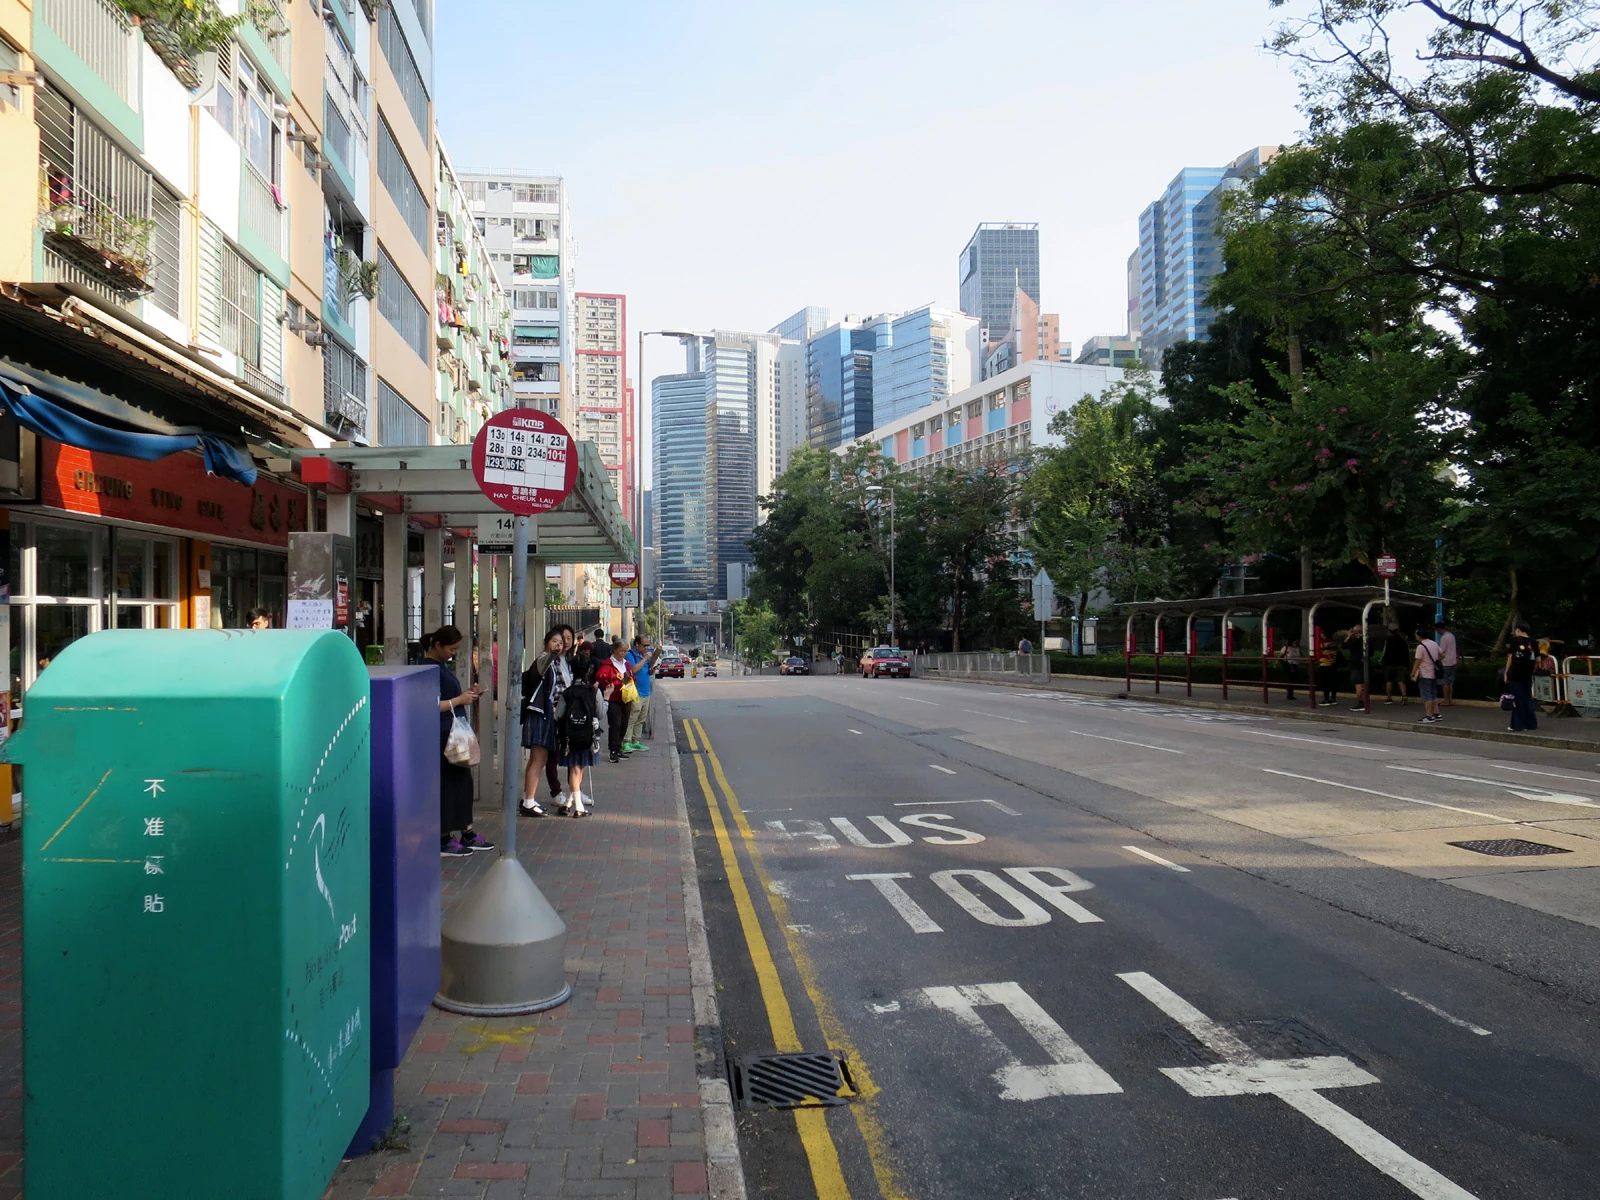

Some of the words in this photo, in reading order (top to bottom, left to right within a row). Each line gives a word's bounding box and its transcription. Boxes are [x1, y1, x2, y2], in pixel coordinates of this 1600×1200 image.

[521, 418, 545, 430] KMB
[490, 429, 506, 440] 13D
[530, 433, 545, 444] 14X
[489, 442, 505, 453] 28B
[511, 445, 522, 456] 89
[527, 447, 547, 459] 234D
[486, 456, 505, 468] N293
[505, 458, 525, 470] N619
[74, 469, 133, 500] CHEUNG
[511, 495, 536, 503] CHEUK
[539, 497, 554, 505] LAU
[496, 518, 515, 530] 14
[768, 866, 1104, 934] TOP
